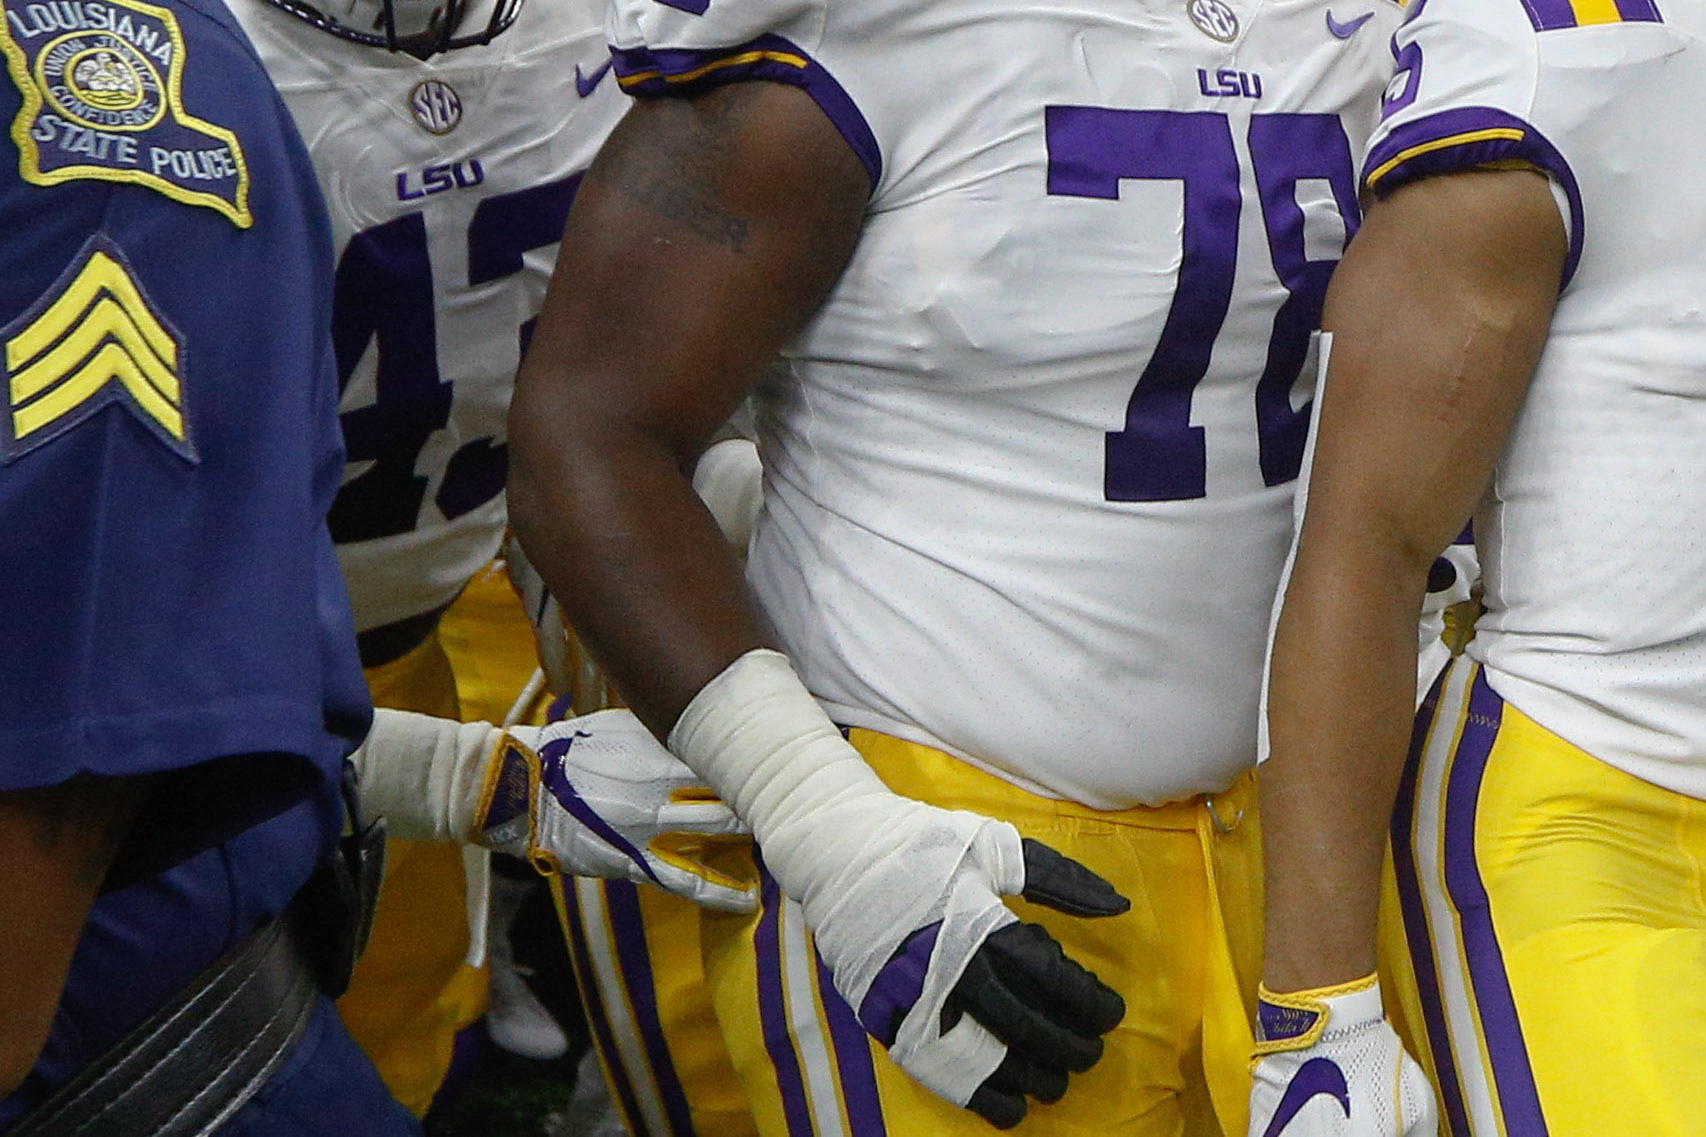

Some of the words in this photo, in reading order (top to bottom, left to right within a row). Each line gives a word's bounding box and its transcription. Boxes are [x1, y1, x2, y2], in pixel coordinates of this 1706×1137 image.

[8, 1, 173, 66] LOUISIANA
[413, 83, 461, 132] SEC
[1197, 68, 1263, 99] LSU
[31, 114, 138, 163] STATE
[149, 147, 238, 180] POLICE
[396, 159, 485, 201] LSU
[1045, 105, 1363, 502] 78
